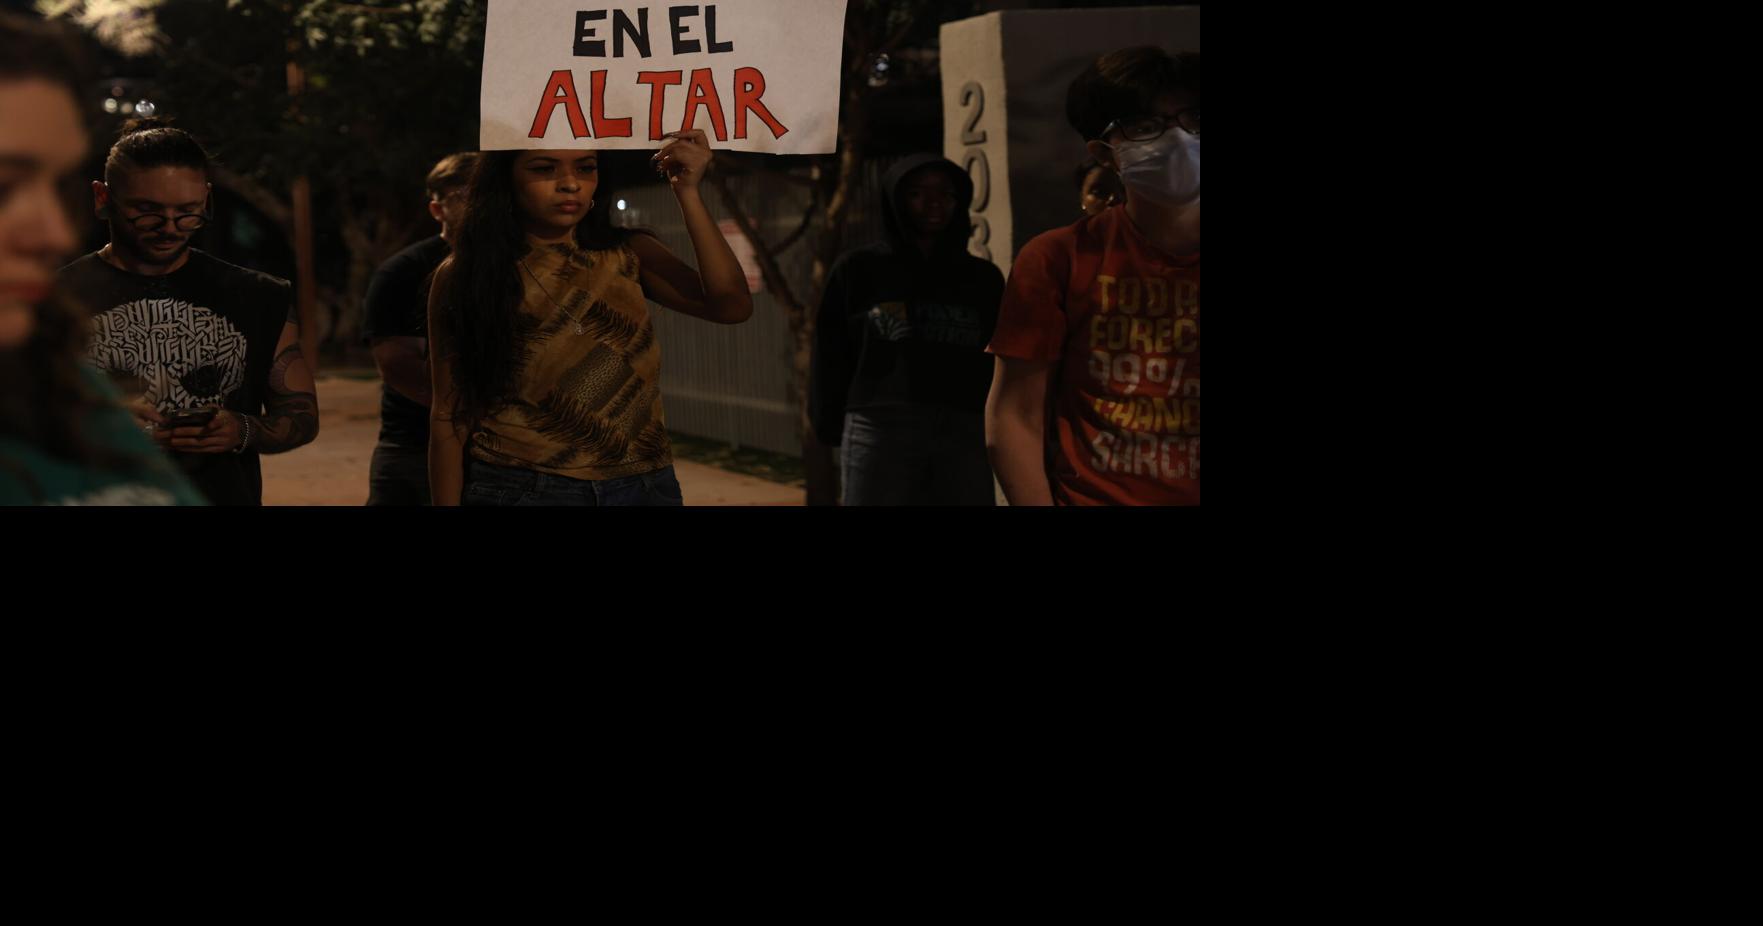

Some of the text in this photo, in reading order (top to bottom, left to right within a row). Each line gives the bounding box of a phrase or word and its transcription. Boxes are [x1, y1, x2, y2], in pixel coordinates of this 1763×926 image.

[573, 5, 733, 58] EN EL
[528, 67, 789, 141] ALTAR
